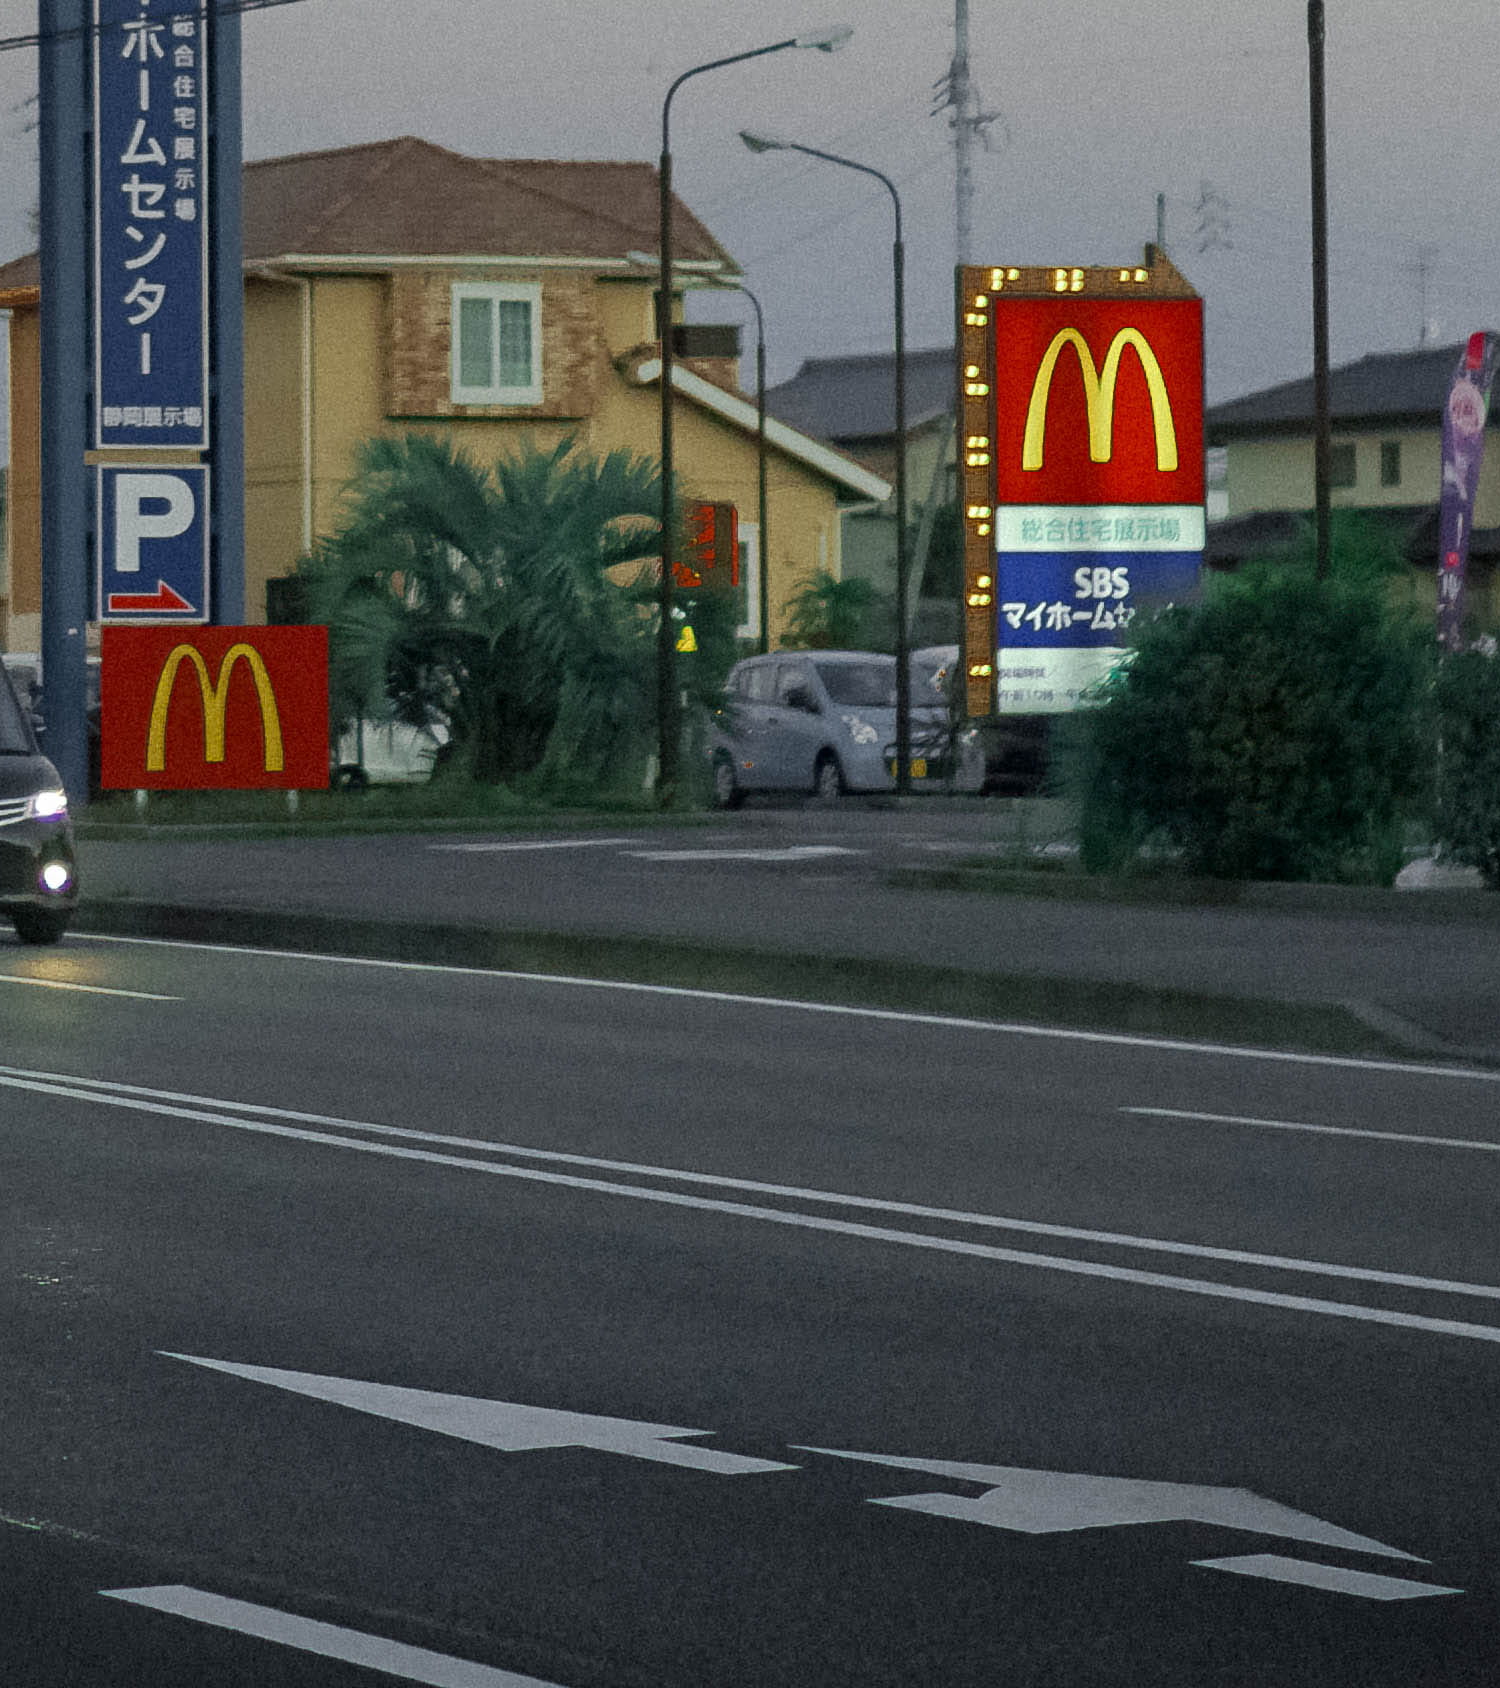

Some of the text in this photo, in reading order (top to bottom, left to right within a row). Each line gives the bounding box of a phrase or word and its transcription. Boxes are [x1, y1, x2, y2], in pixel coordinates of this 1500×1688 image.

[172, 14, 197, 222] 総合住宅展示場
[115, 473, 195, 573] P
[1021, 517, 1182, 543] 総合住宅展示場
[1073, 566, 1130, 600] SBS
[1002, 600, 1137, 632] マイホームセ
